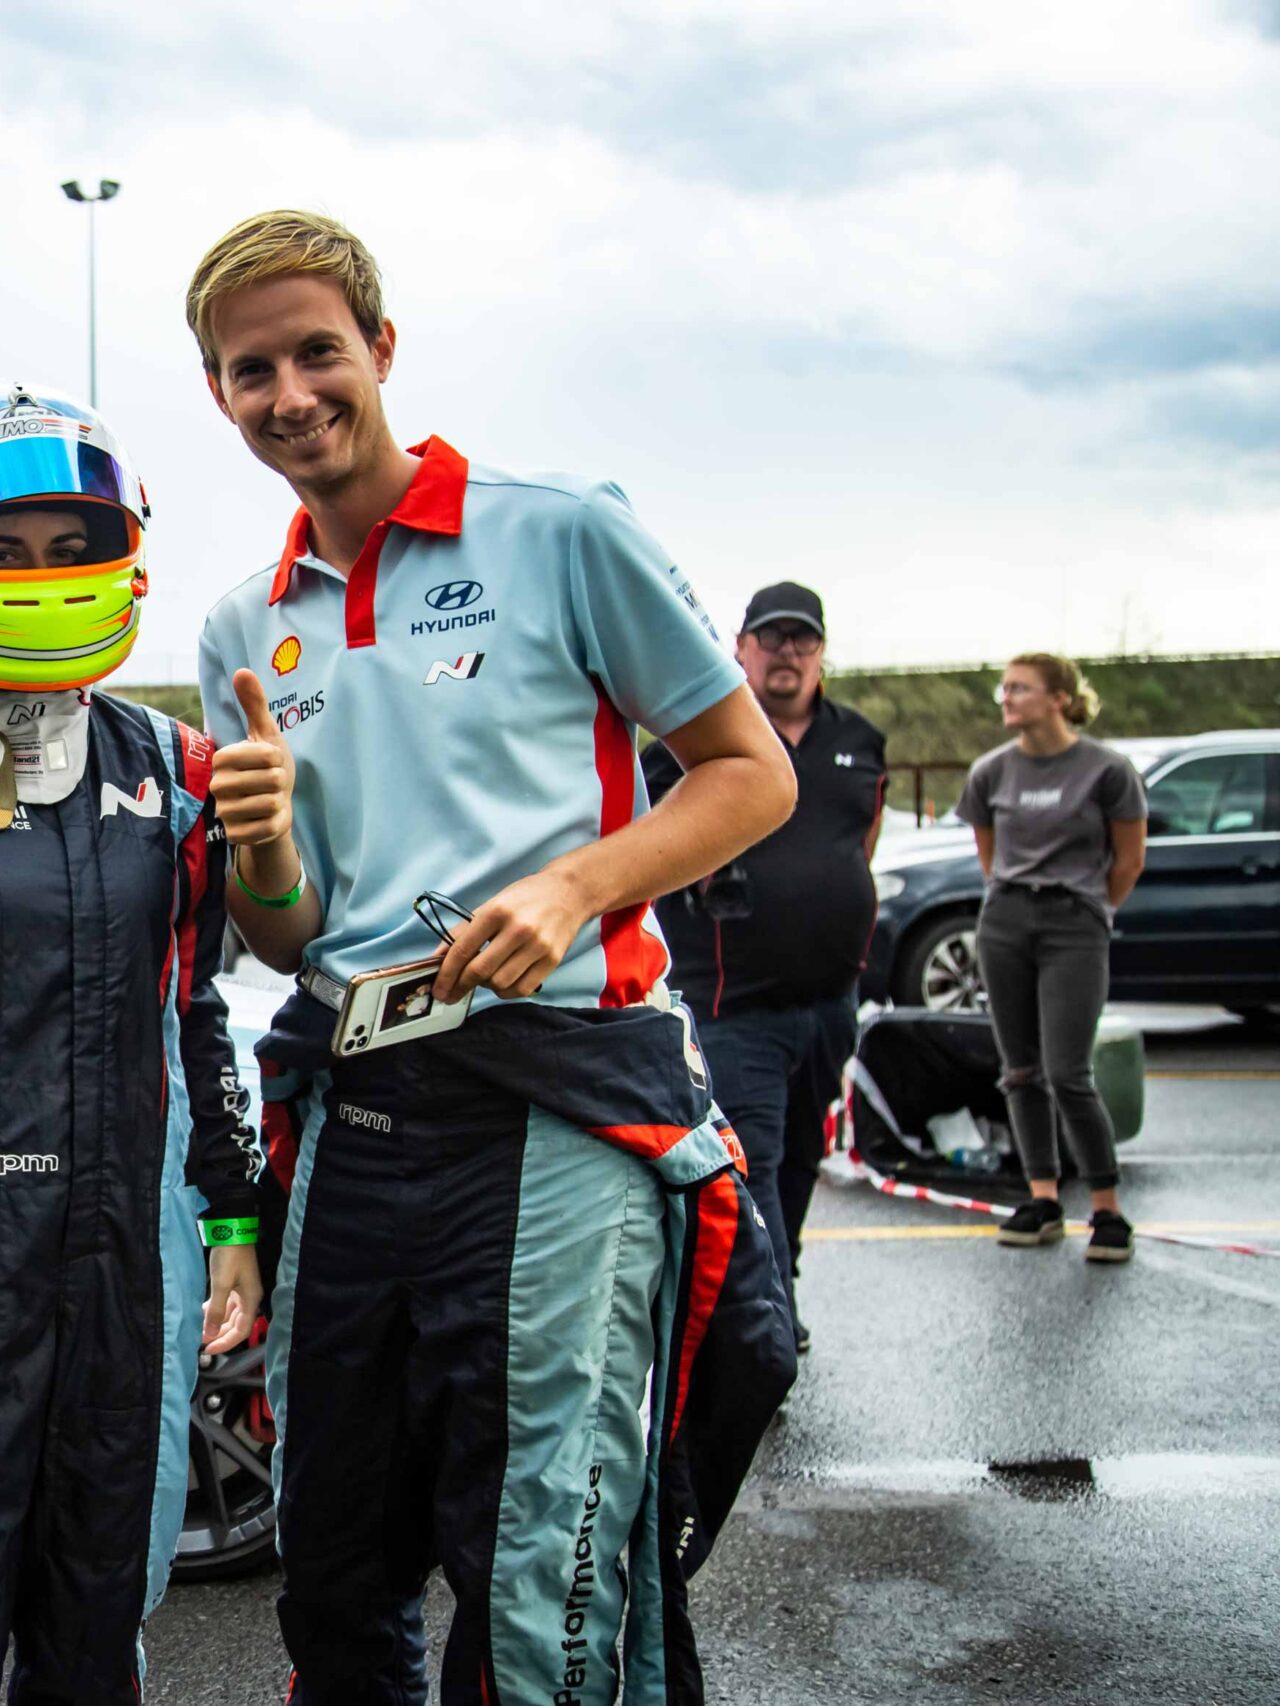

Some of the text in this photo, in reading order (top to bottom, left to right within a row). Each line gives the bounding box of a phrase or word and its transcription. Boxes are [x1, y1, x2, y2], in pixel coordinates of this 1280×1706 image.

[411, 609, 496, 635] HYUNDAI
[268, 692, 297, 712] NDAI
[340, 1103, 391, 1132] rpm
